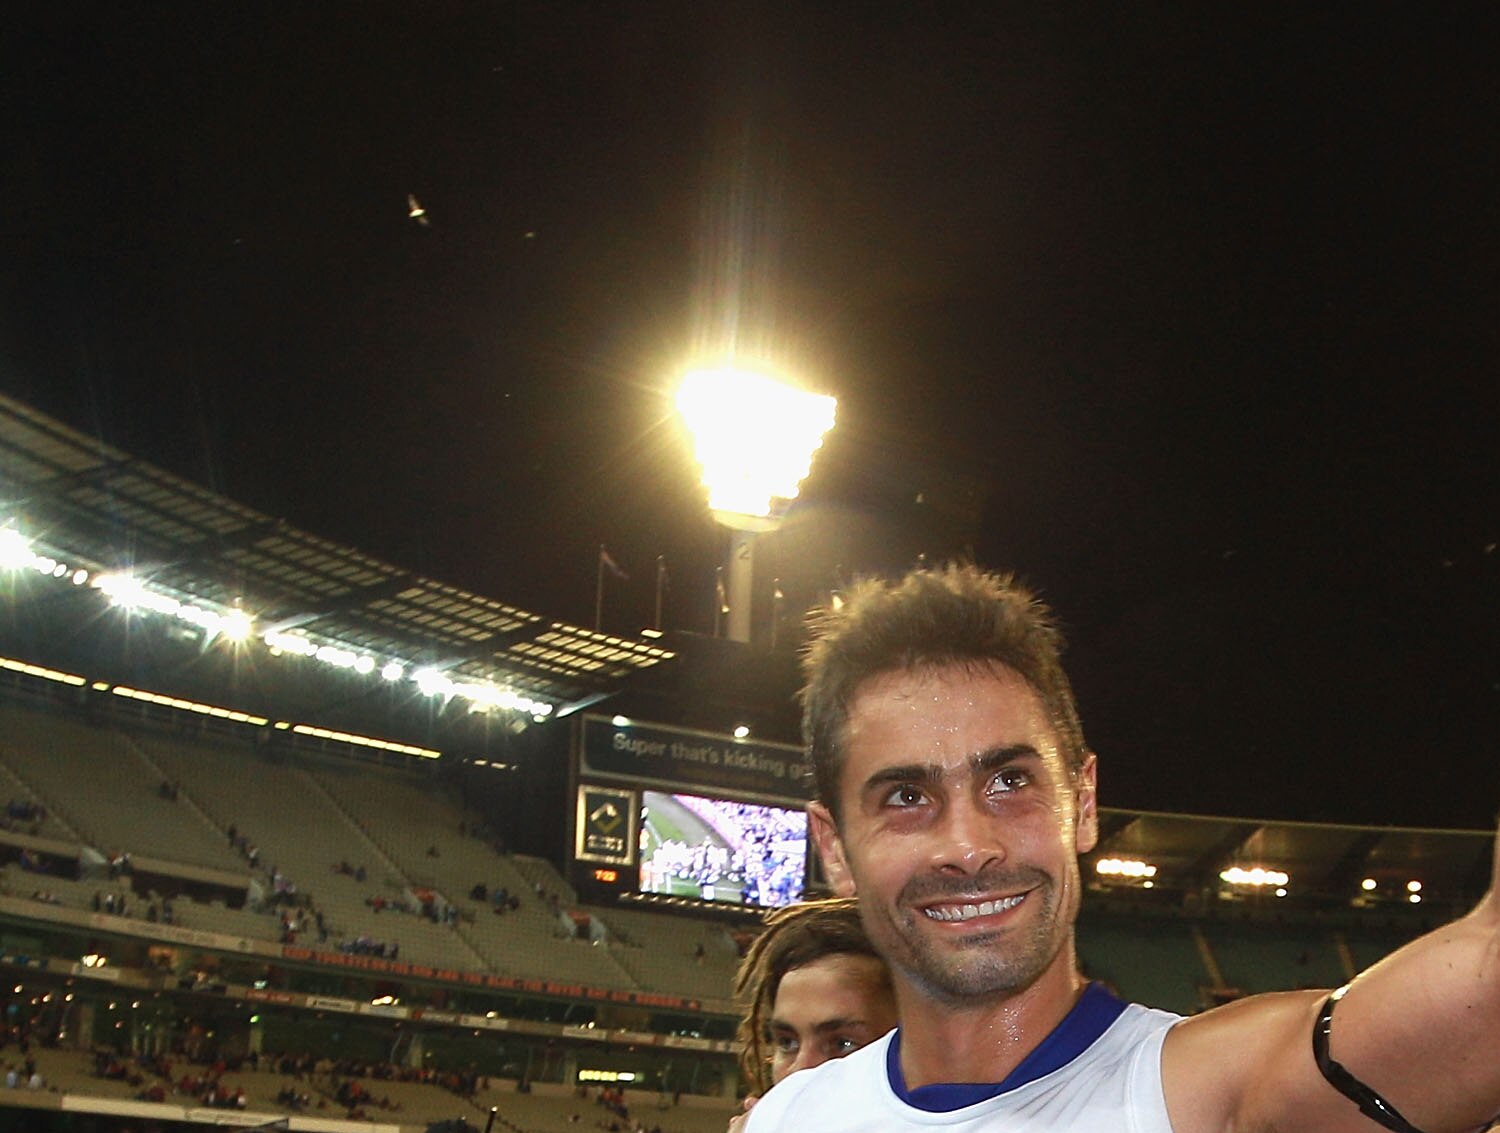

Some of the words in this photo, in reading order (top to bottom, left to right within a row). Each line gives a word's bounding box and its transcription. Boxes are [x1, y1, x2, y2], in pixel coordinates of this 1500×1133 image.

[613, 732, 666, 756] Super
[671, 742, 719, 764] that's
[724, 750, 786, 778] kicking
